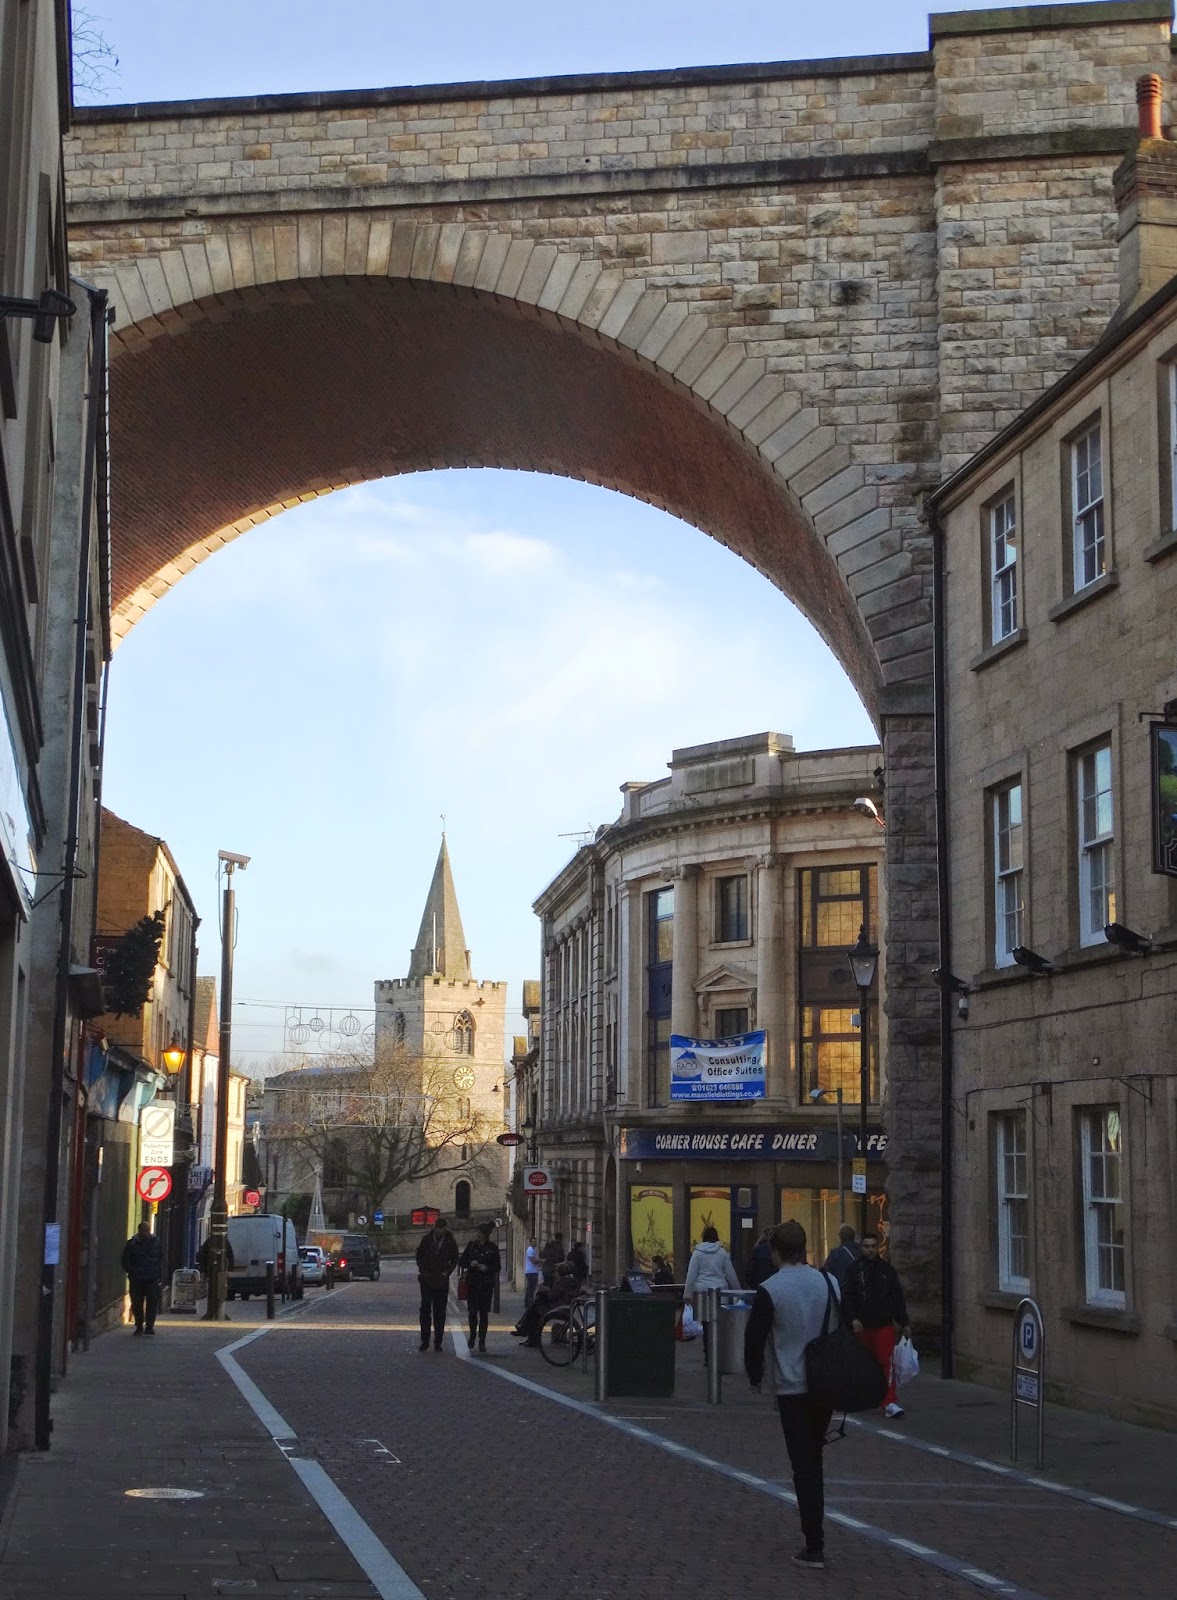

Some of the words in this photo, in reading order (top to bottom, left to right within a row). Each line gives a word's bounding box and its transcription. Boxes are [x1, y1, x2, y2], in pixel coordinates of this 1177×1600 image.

[688, 1038, 711, 1048] TO
[715, 1036, 745, 1048] LET
[707, 1067, 733, 1076] Office
[735, 1066, 763, 1075] Suites
[655, 1134, 690, 1150] CORNER
[691, 1134, 729, 1150] HOUSE
[730, 1133, 764, 1150] CAFE
[772, 1134, 817, 1150] DINER
